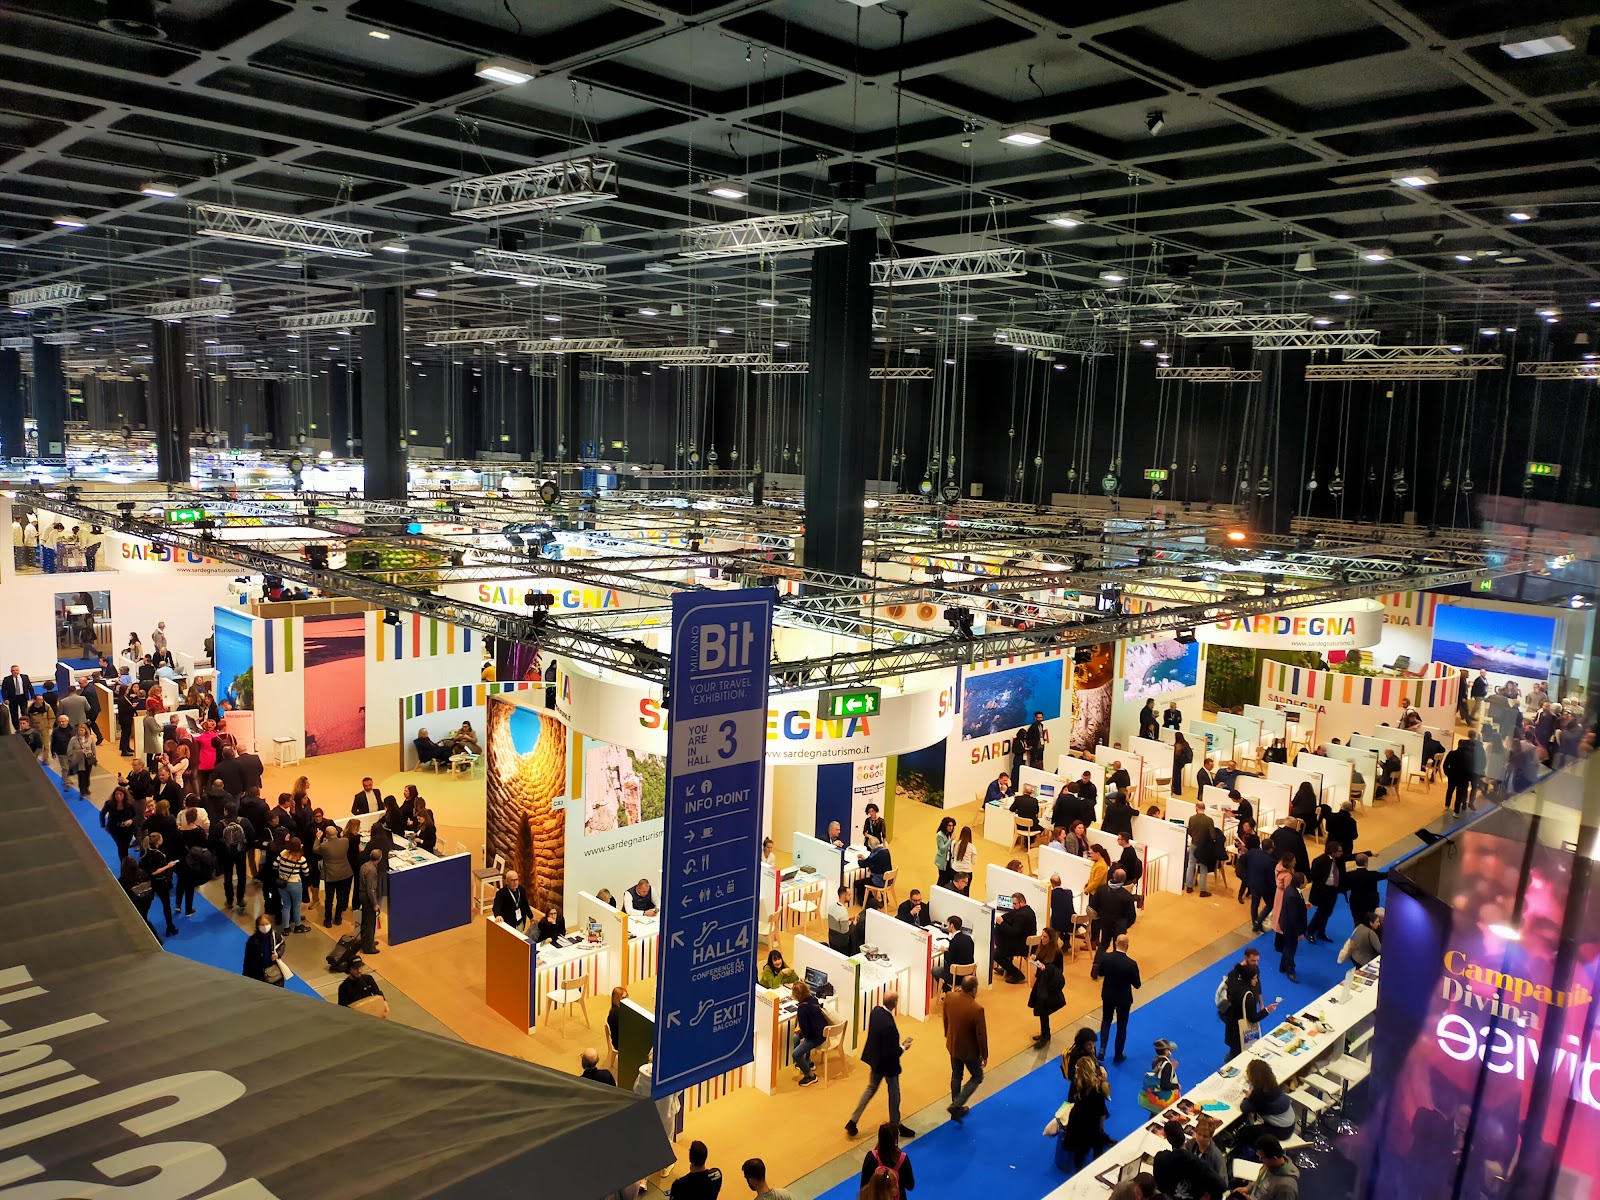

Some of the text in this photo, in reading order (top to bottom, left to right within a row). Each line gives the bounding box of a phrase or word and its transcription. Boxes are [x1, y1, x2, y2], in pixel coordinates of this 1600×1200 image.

[690, 625, 700, 673] MILANO
[690, 678, 752, 694] YOUR TRAVEL
[688, 724, 708, 736] YOU
[717, 719, 738, 759] 3
[687, 734, 707, 746] ARE
[687, 747, 697, 757] IN
[687, 755, 711, 767] HALL
[685, 788, 751, 814] INFO POINT
[692, 924, 749, 965] HALL 4
[691, 961, 735, 981] CONFERENCE
[711, 968, 735, 981] ROOMS
[1441, 976, 1542, 1031] Divina
[713, 1000, 746, 1026] EXIT
[712, 1017, 742, 1033] BALCONY
